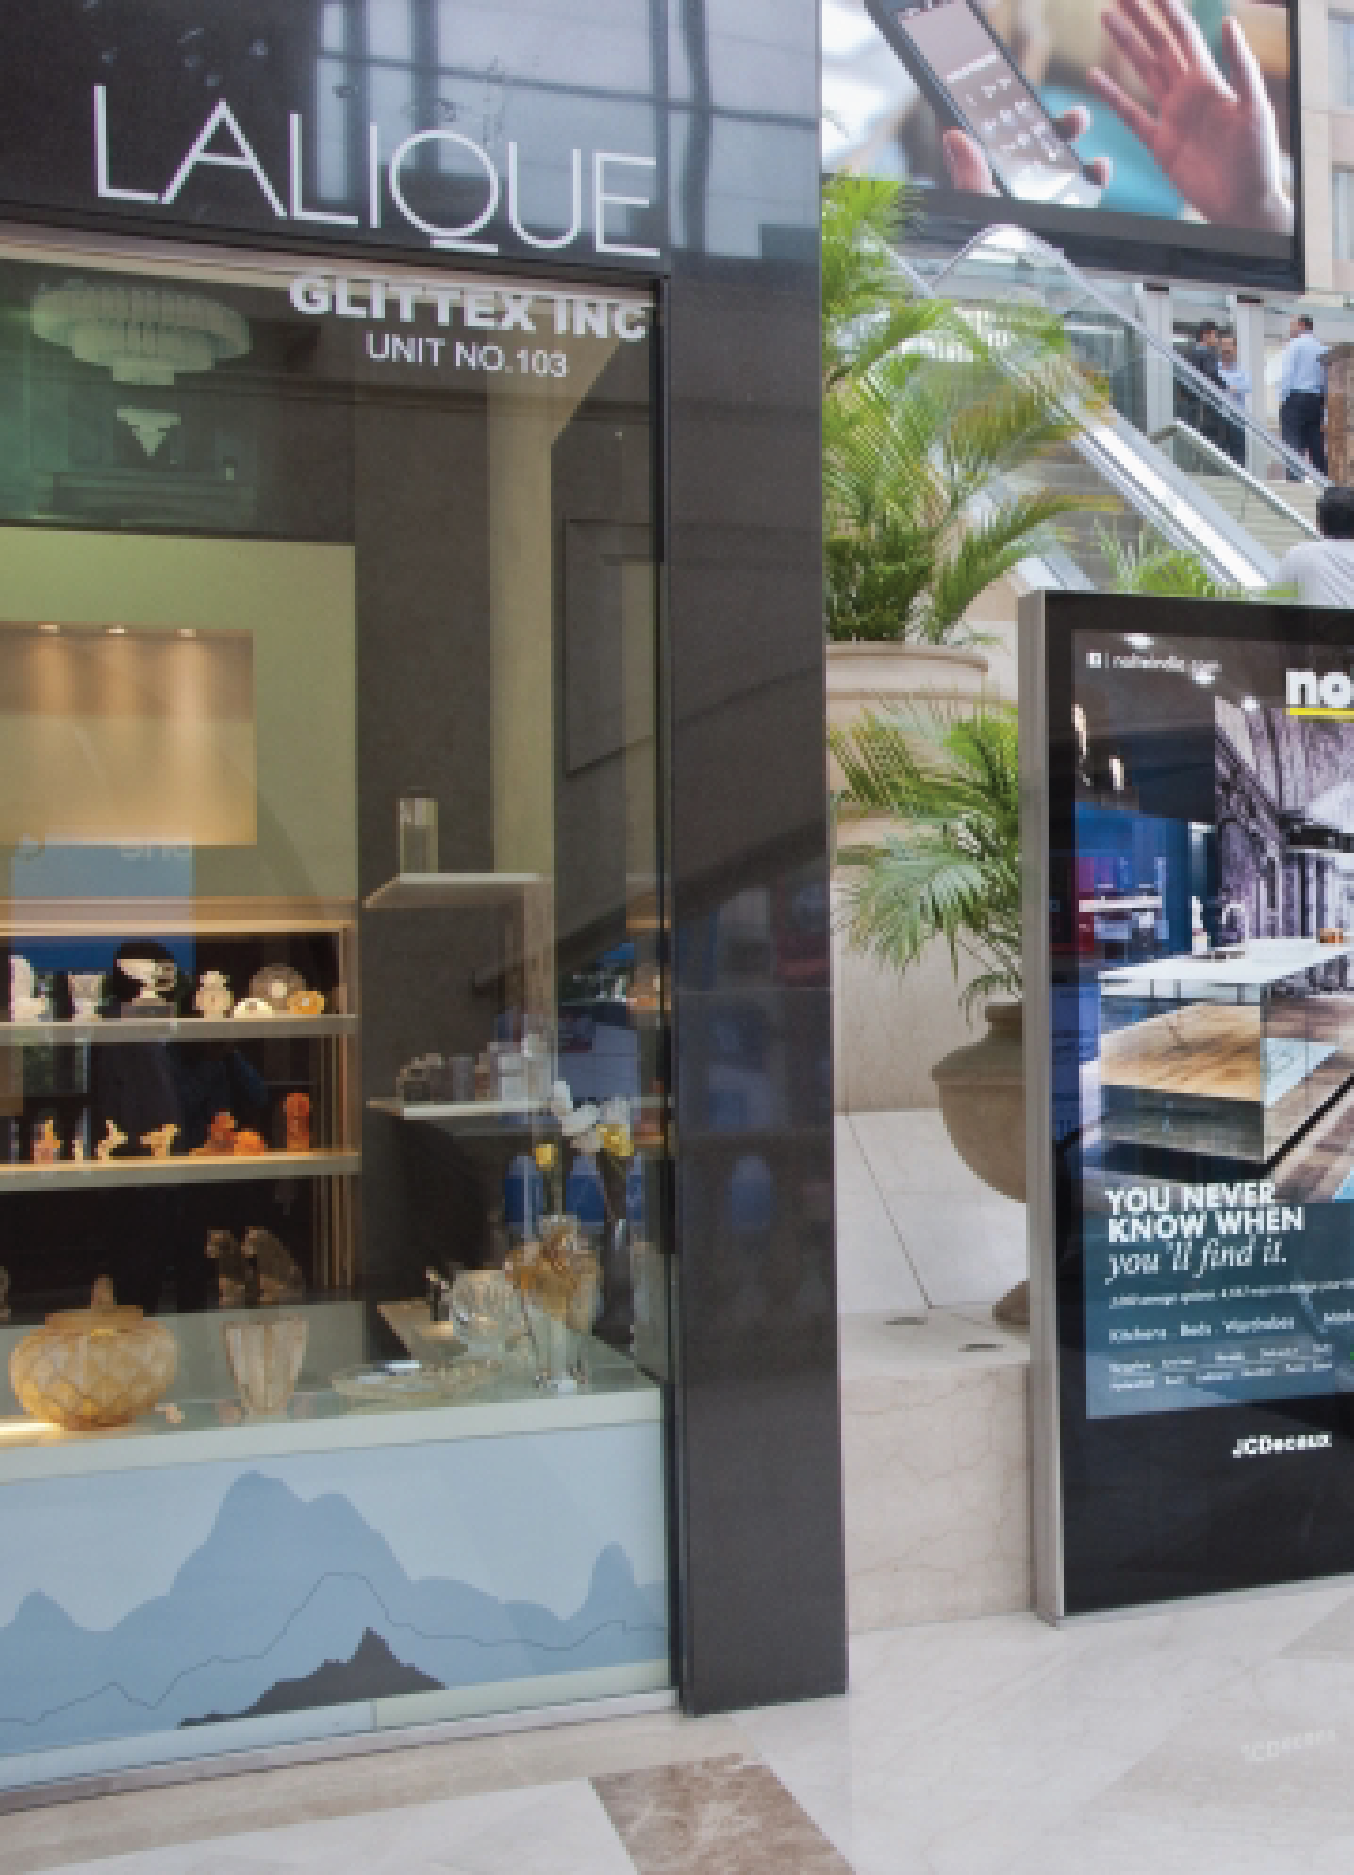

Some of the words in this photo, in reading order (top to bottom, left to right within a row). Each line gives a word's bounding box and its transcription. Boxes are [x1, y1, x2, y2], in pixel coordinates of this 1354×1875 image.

[93, 83, 662, 257] LALIQUE
[289, 274, 536, 332] GLITTEX
[551, 300, 648, 342] INC
[365, 331, 445, 364] UNIT
[454, 342, 568, 378] NO.103
[1104, 1186, 1171, 1215] YOU
[1182, 1182, 1277, 1210] NEVER
[1108, 1212, 1206, 1242] KNOW
[1215, 1206, 1305, 1234] WHEN
[1193, 1236, 1255, 1278] find
[1232, 1431, 1333, 1458] JCDecaux
